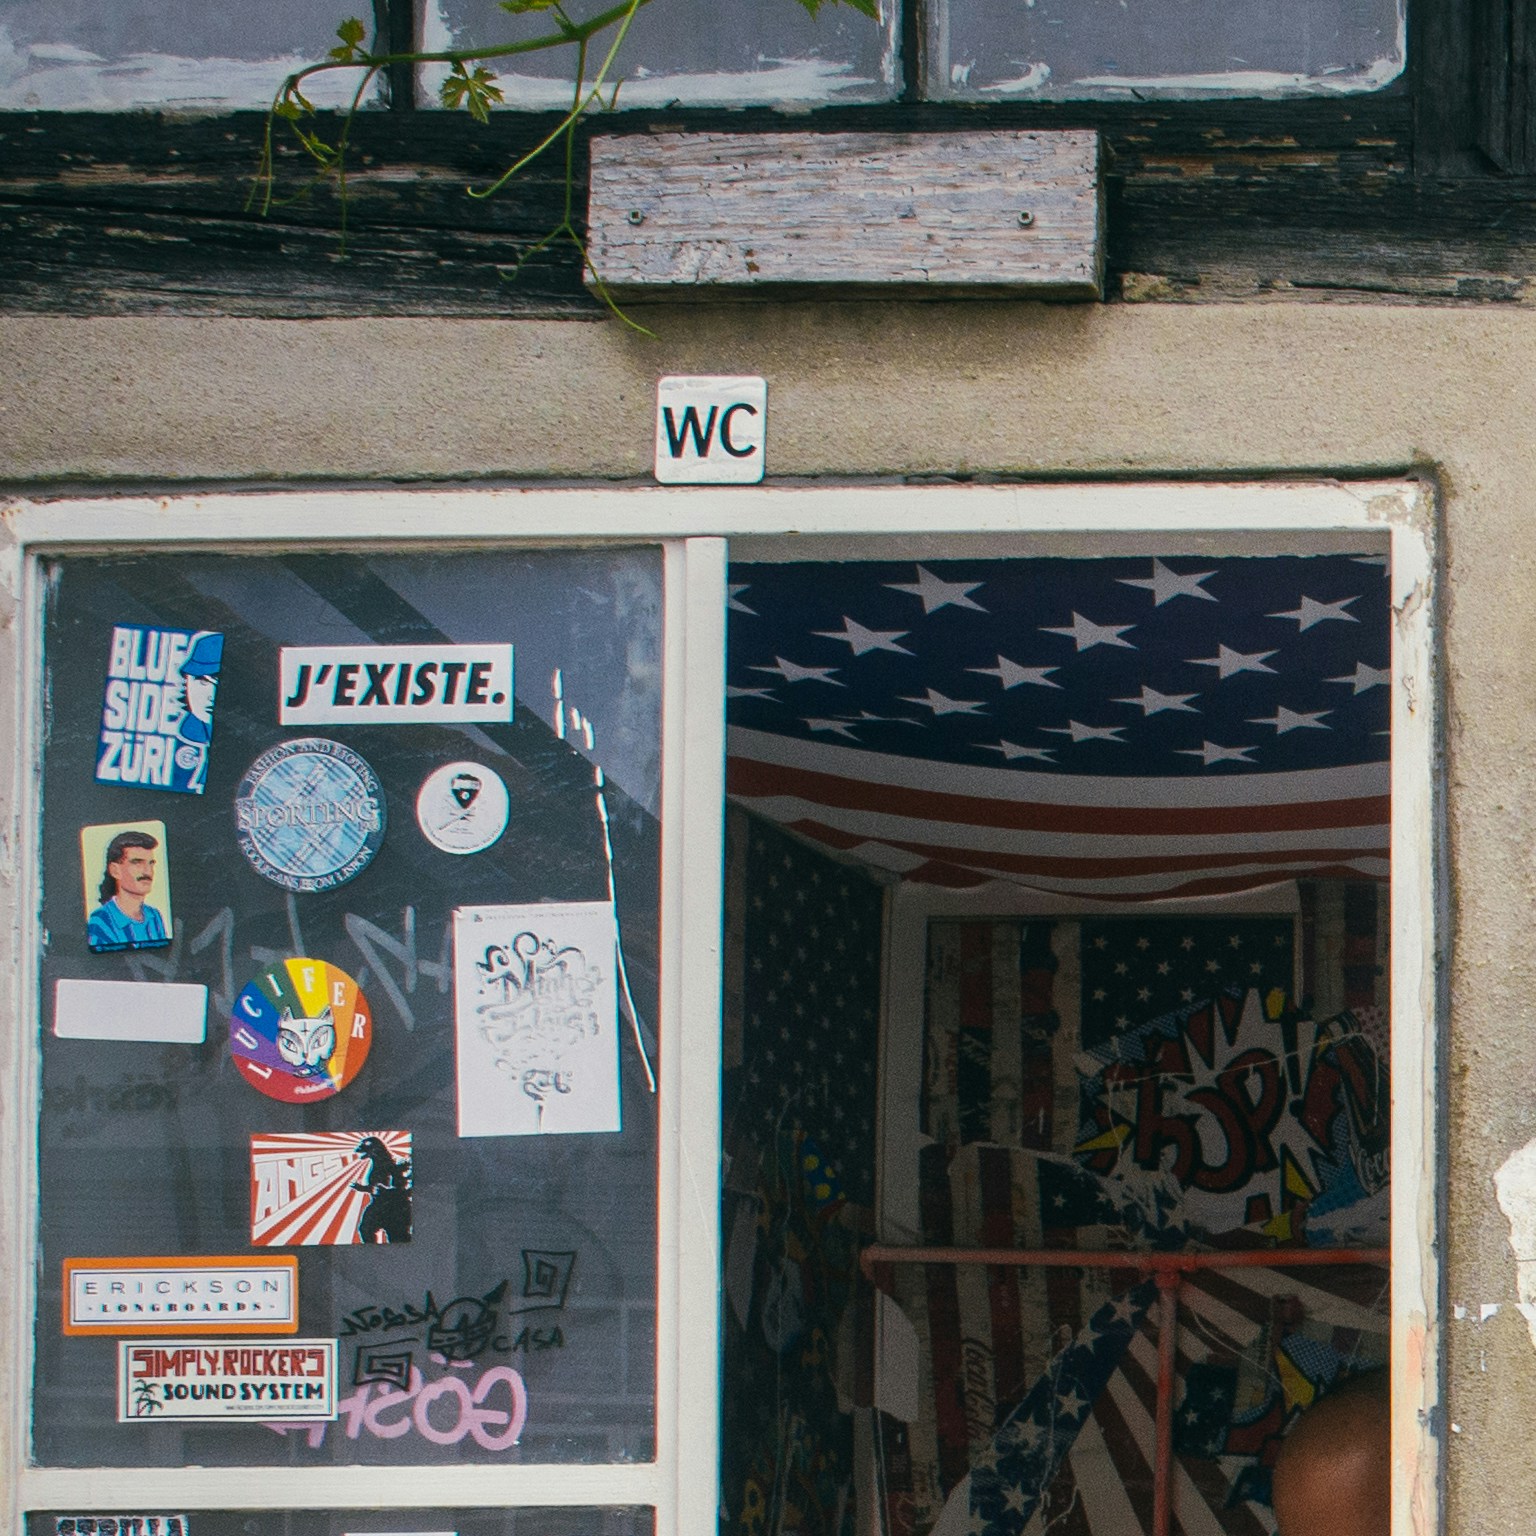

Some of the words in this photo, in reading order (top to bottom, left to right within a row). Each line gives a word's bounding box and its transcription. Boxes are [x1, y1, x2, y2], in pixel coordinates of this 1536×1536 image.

[663, 402, 758, 459] WC
[108, 626, 189, 686] BLUE
[103, 680, 187, 736] SIDE
[96, 730, 176, 786] ZÜRI
[85, 1280, 279, 1295] ERICKSON
[164, 1383, 235, 1400] SOUND
[241, 1382, 324, 1400] SYSTEM
